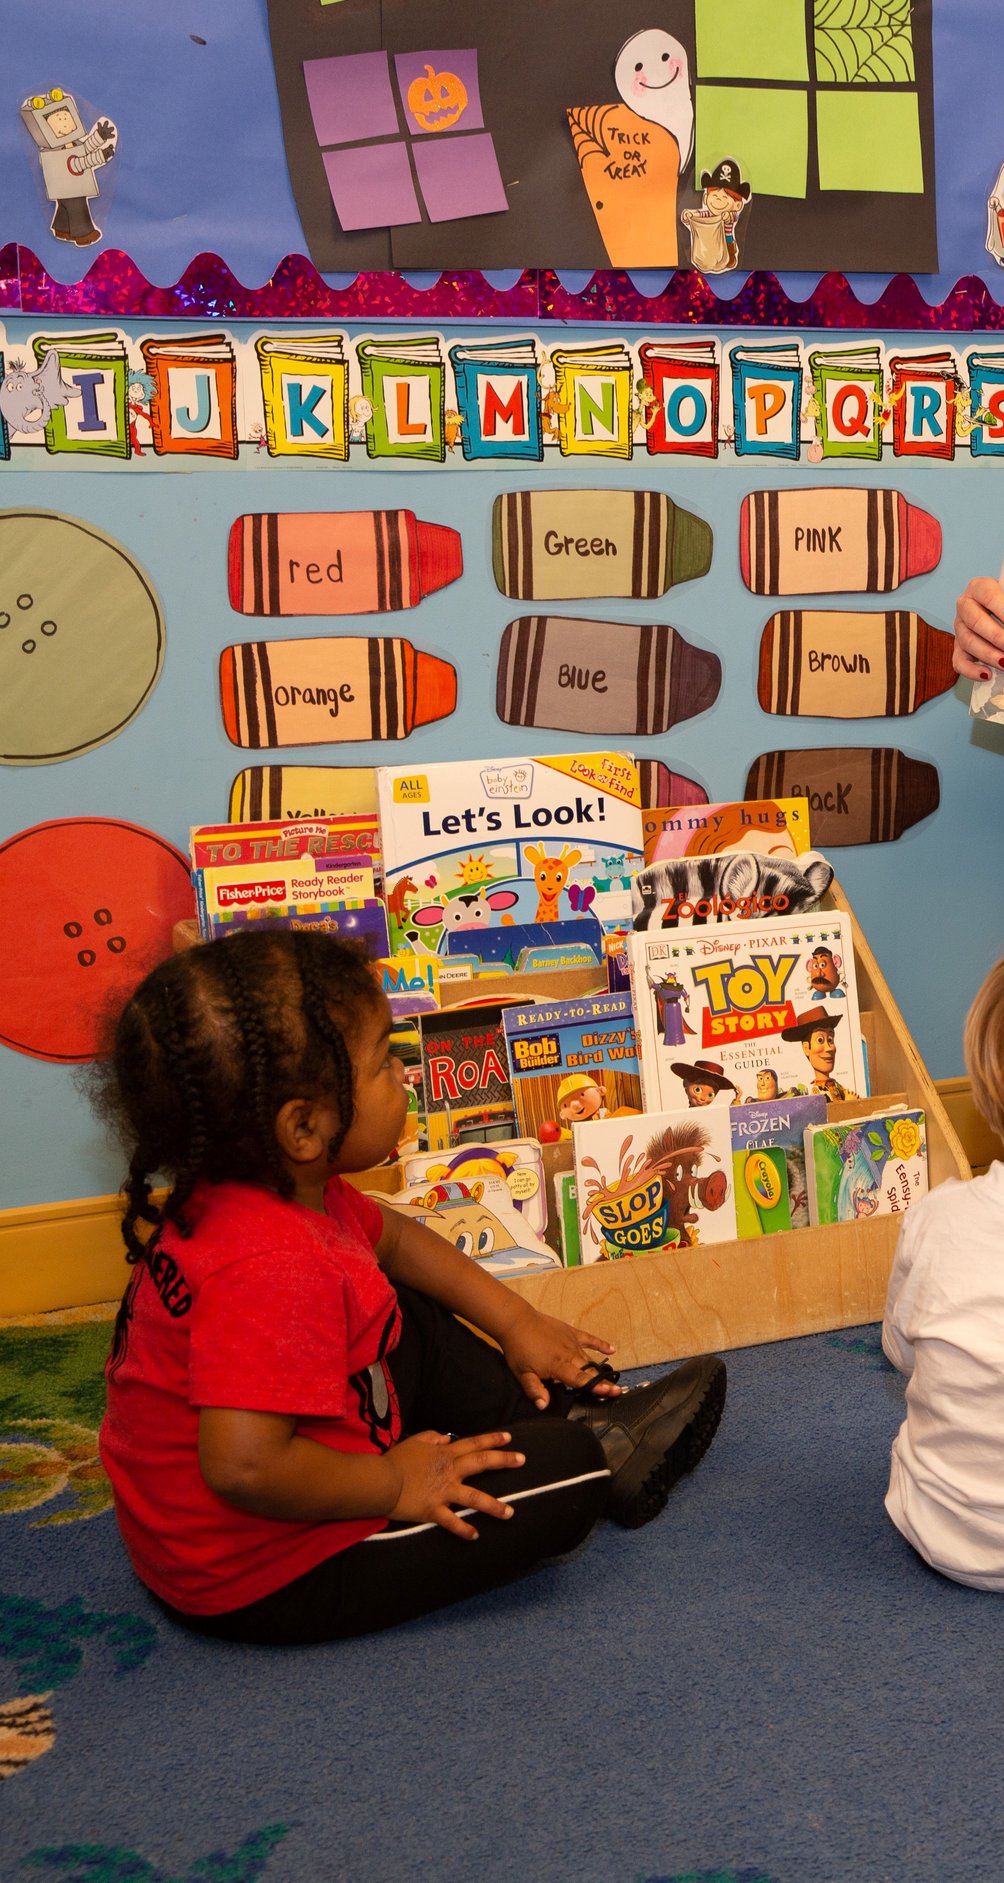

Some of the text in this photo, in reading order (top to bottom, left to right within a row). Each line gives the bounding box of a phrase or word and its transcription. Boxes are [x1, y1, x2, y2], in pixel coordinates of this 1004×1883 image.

[607, 127, 651, 145] TRICK
[623, 150, 641, 161] OR
[603, 160, 648, 180] TREAT
[72, 372, 106, 432] I
[176, 375, 210, 432] J
[286, 382, 334, 437] K
[396, 382, 427, 435] L
[483, 380, 531, 437] M
[578, 381, 619, 434] N
[666, 385, 708, 430] O
[753, 385, 788, 436] P
[837, 384, 873, 438] Q
[910, 385, 949, 438] R
[543, 529, 617, 557] Green
[794, 526, 843, 554] PINK
[289, 549, 344, 584] red
[808, 649, 871, 675] Brown
[557, 664, 608, 693] Blue
[486, 773, 508, 787] baby
[569, 759, 596, 781] Look
[399, 778, 423, 791] ALL
[489, 780, 528, 795] einstein
[401, 791, 423, 800] AGES
[422, 797, 607, 837] Let's Look!
[741, 808, 800, 828] hugs
[282, 825, 327, 838] Picture Me
[206, 843, 242, 863] TO
[249, 838, 299, 860] THE
[325, 860, 362, 869] Kindergarten
[291, 873, 364, 889] Ready Reader
[292, 886, 345, 901] Storybook
[661, 891, 790, 920] Zoológico
[608, 941, 624, 952] NICK
[749, 936, 787, 948] PIXAR
[532, 954, 593, 969] Barney Backhoe
[383, 964, 435, 994] Me!
[691, 954, 802, 1015] TOY
[711, 1010, 789, 1035] STORY
[426, 1033, 496, 1054] ON THE
[514, 1037, 558, 1060] Bob
[720, 1046, 784, 1062] ESSENTIAL
[520, 1054, 560, 1069] Builder
[566, 1046, 637, 1068] Bird Wa
[734, 1058, 771, 1070] GUIDE
[731, 1114, 791, 1136] FROZEN
[749, 1110, 768, 1119] Disney
[758, 1161, 775, 1199] Crayola
[599, 1184, 662, 1226] SLOP
[613, 1216, 664, 1246] GOES
